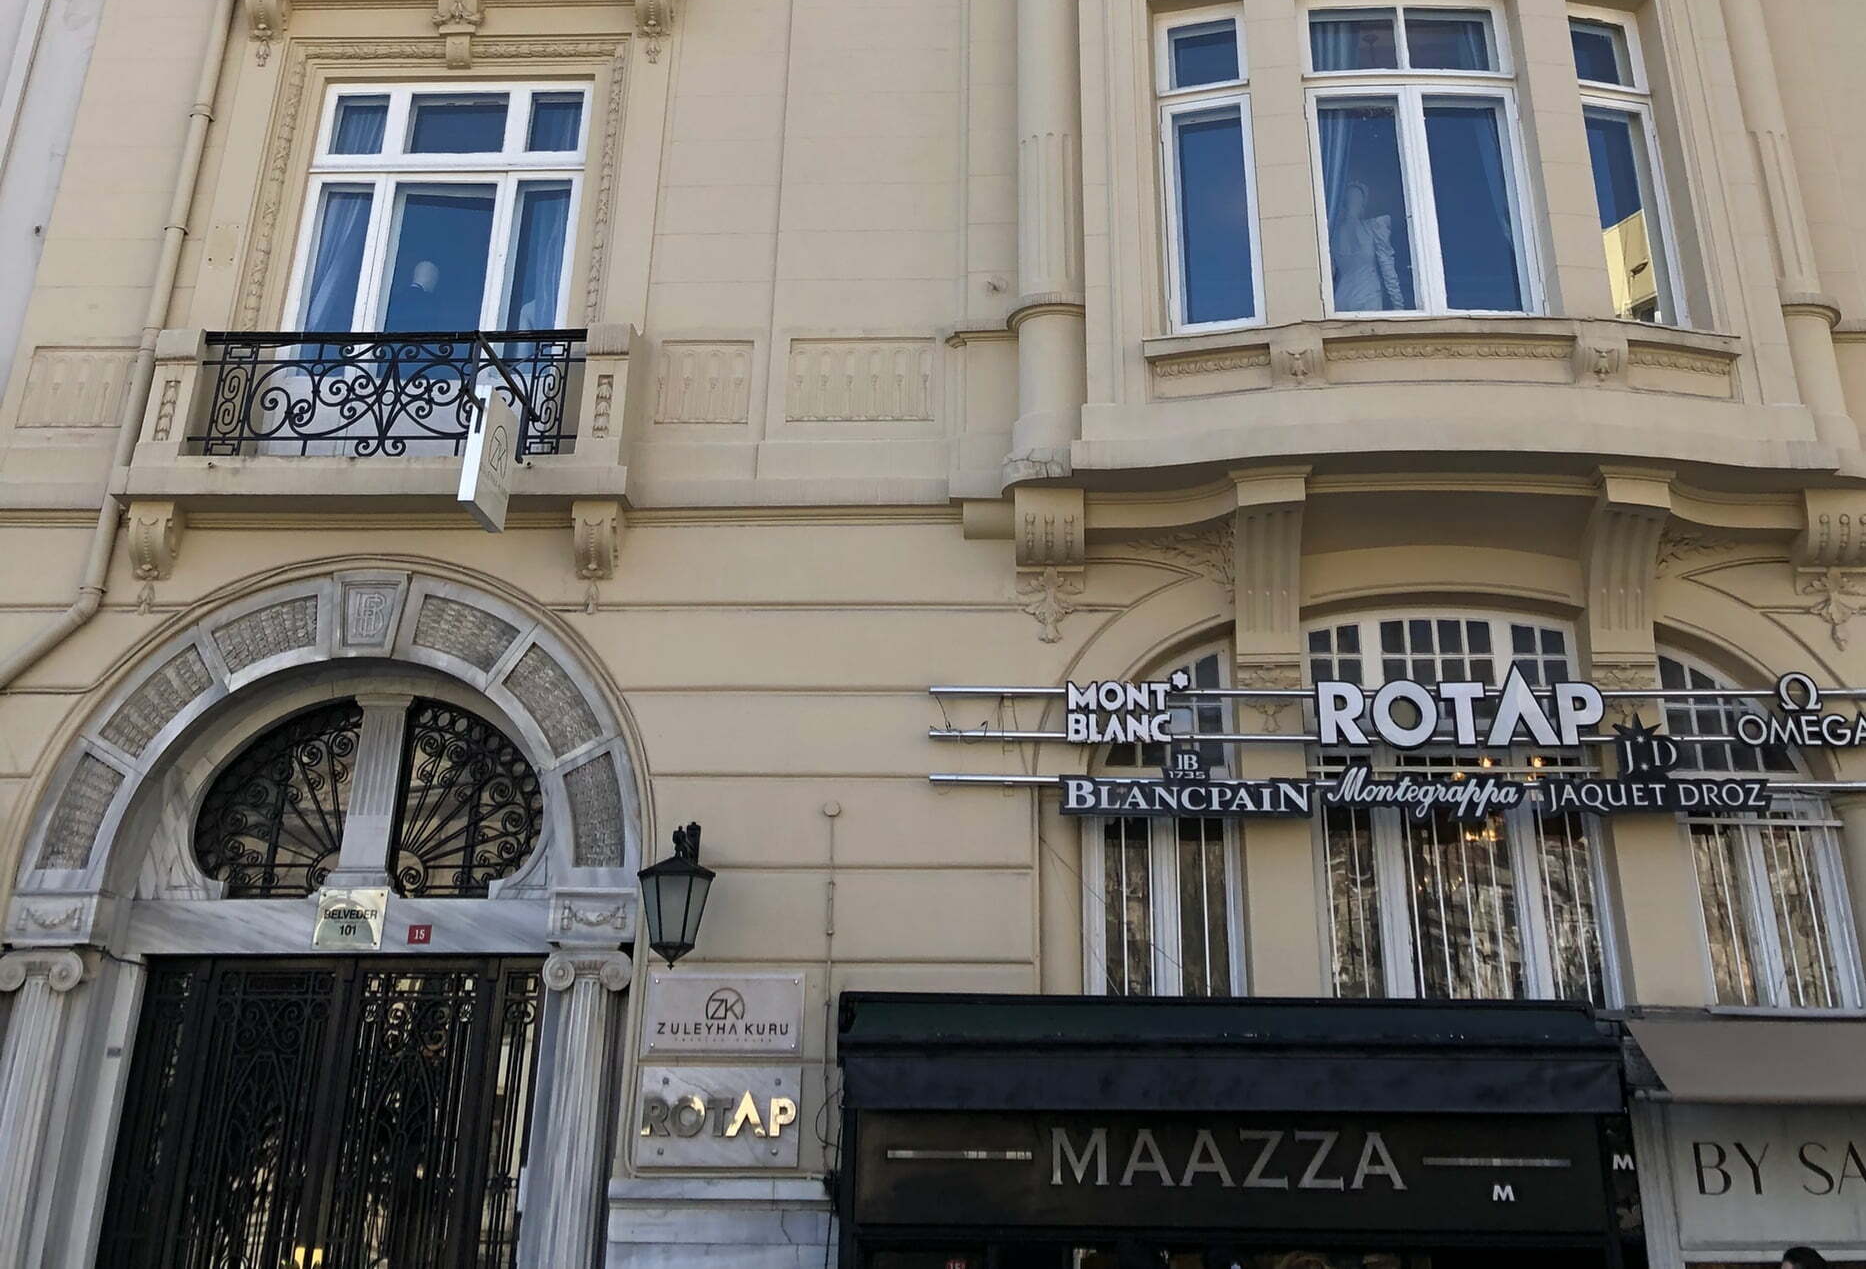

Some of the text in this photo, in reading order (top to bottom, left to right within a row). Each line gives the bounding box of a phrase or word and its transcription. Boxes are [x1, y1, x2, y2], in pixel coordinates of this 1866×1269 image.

[1067, 681, 1171, 711] MONT
[1317, 663, 1604, 747] ROTAP
[1067, 713, 1173, 743] BLANC
[1168, 770, 1206, 779] 1735
[1064, 780, 1312, 813] BLANCPAIN
[1327, 766, 1519, 819] Montegrappa
[1550, 784, 1767, 813] JAQUET DROZ
[324, 909, 377, 920] BELVEDER
[340, 924, 356, 936] 101
[414, 929, 425, 940] 15
[656, 1022, 789, 1035] ZULEYHA KURU
[641, 1090, 797, 1138] ROTAP
[1050, 1127, 1408, 1191] MAAZZA
[1612, 1154, 1634, 1170] M
[1693, 1140, 1866, 1195] BY SA
[1493, 1185, 1515, 1202] M
